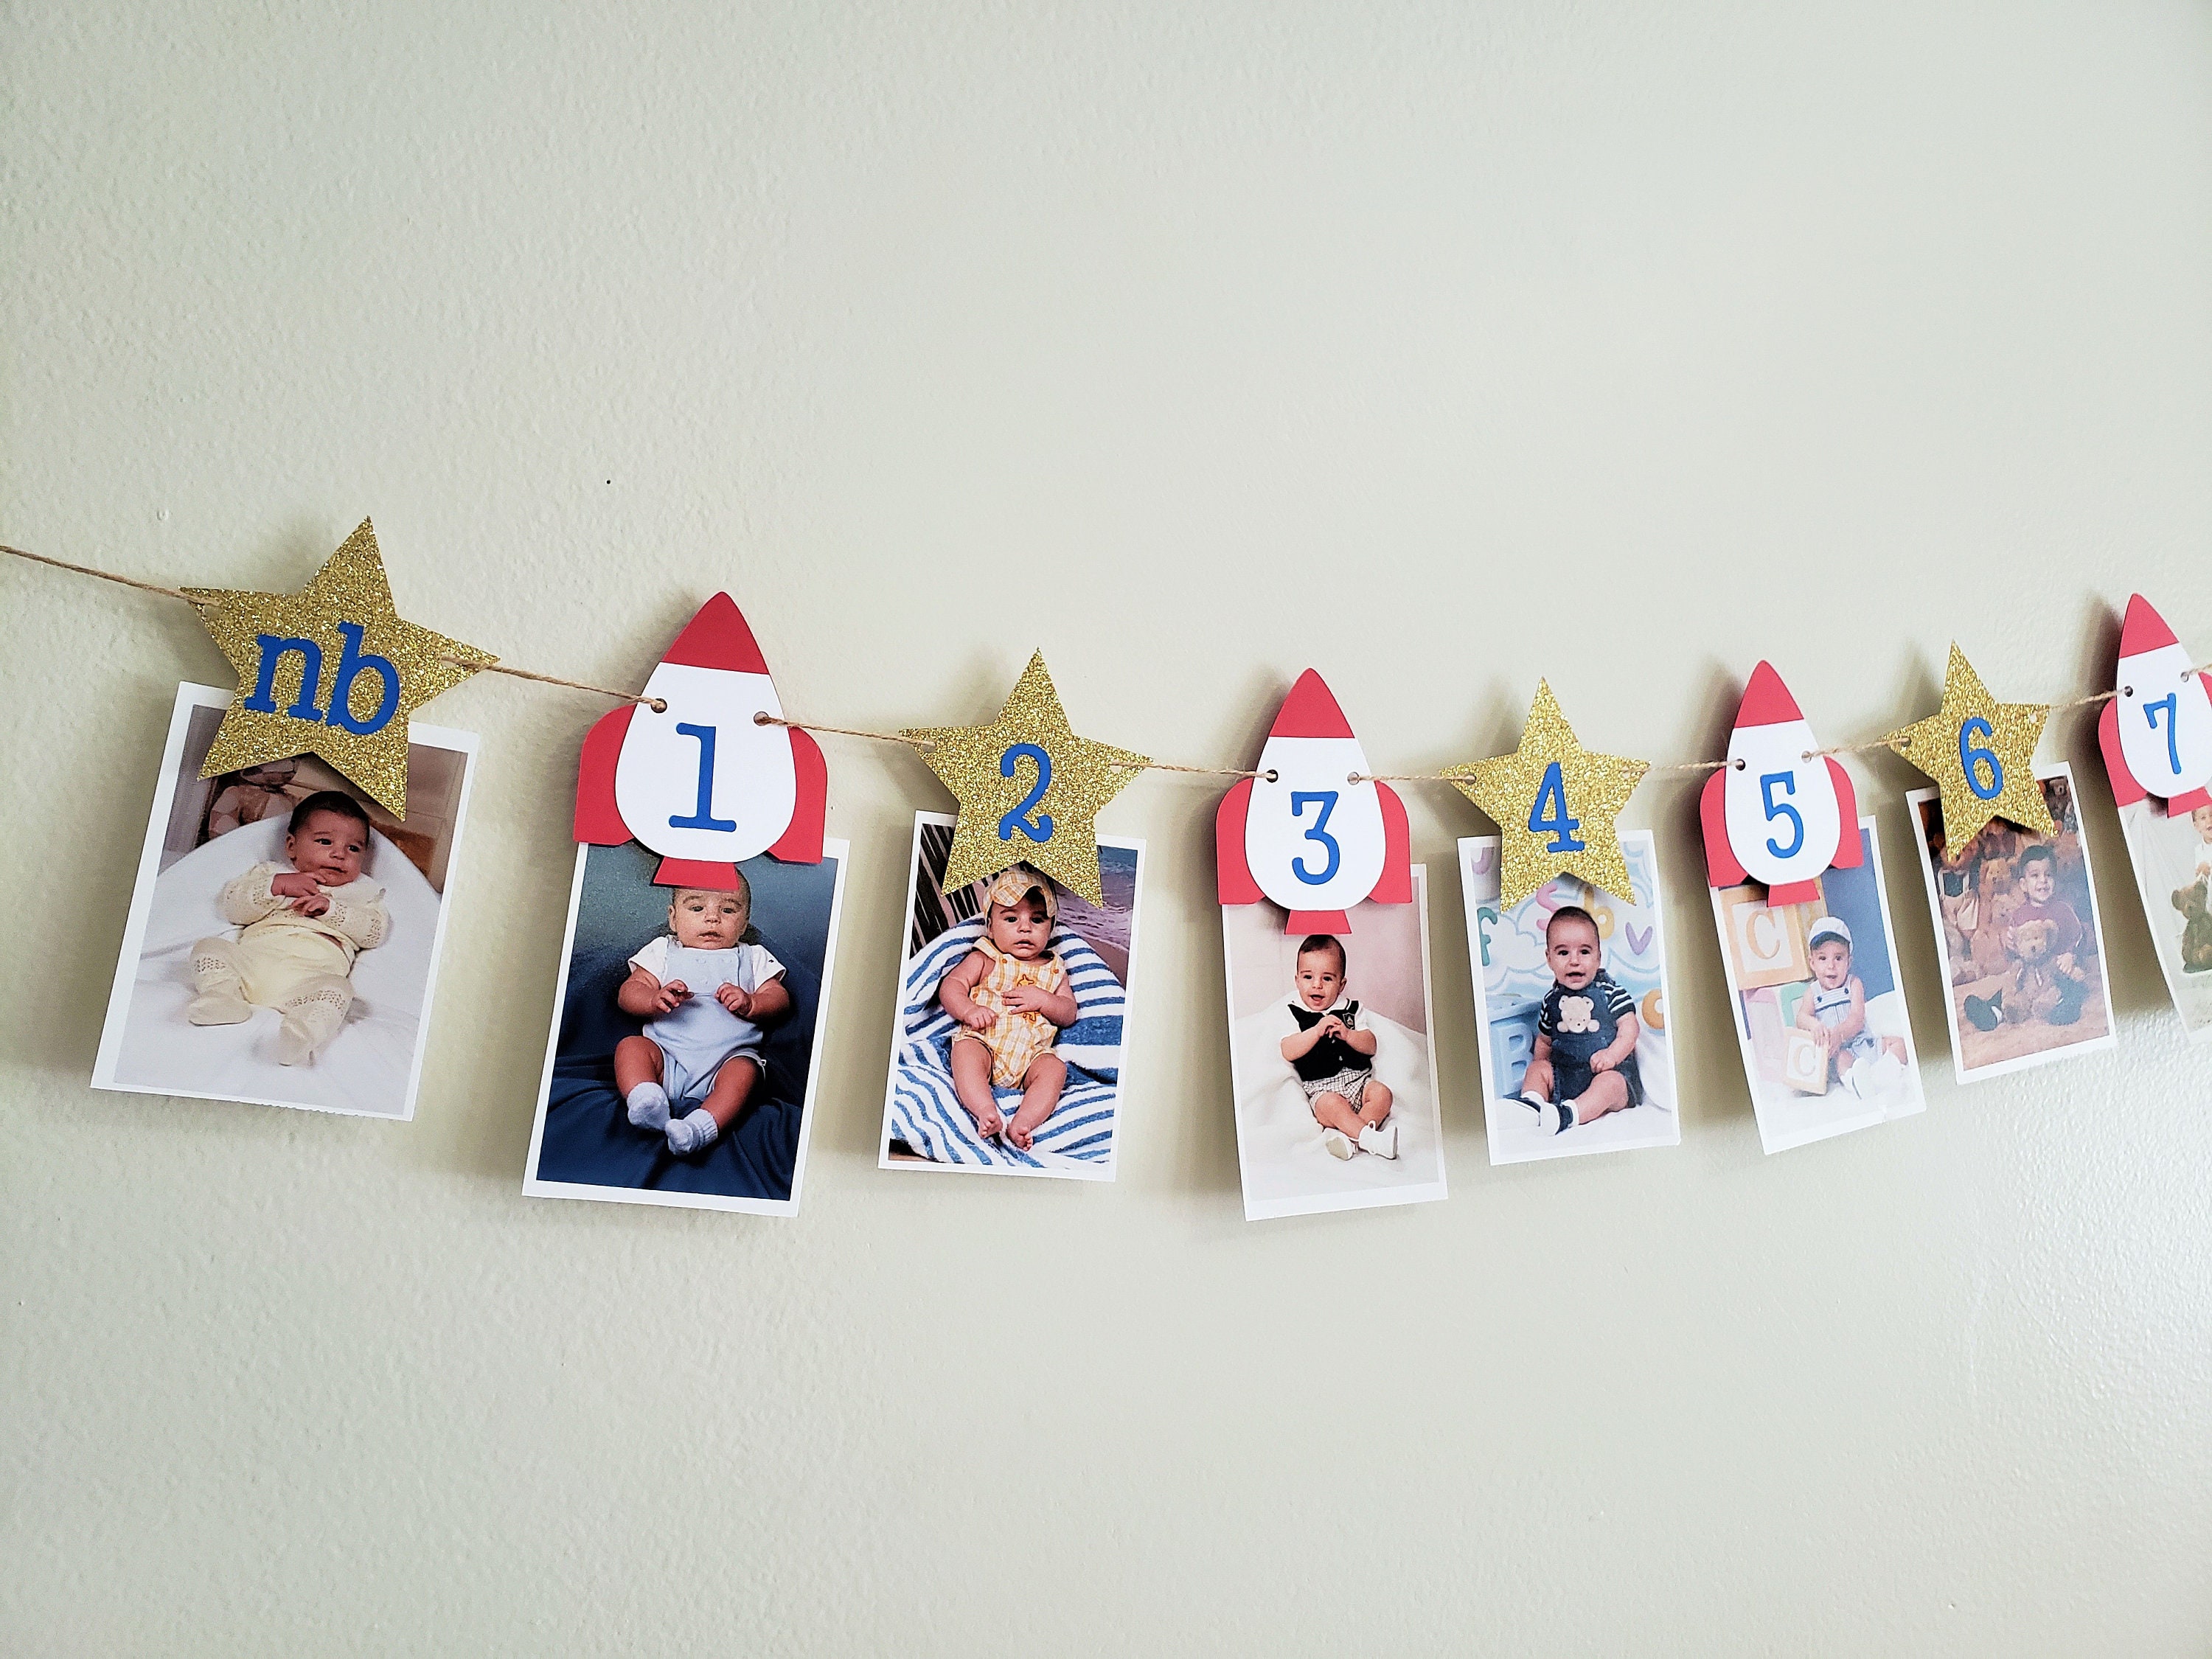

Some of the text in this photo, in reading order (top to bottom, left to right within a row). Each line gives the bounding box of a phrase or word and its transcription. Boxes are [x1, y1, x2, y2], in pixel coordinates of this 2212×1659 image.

[245, 621, 400, 735] nb
[667, 722, 737, 832] 1
[1959, 716, 2003, 801] 6
[2143, 692, 2182, 775] 7
[998, 742, 1054, 843] 2
[1290, 790, 1340, 886] 3
[1528, 762, 1585, 853] 4
[1760, 770, 1805, 860] 5
[1745, 909, 1781, 959] C
